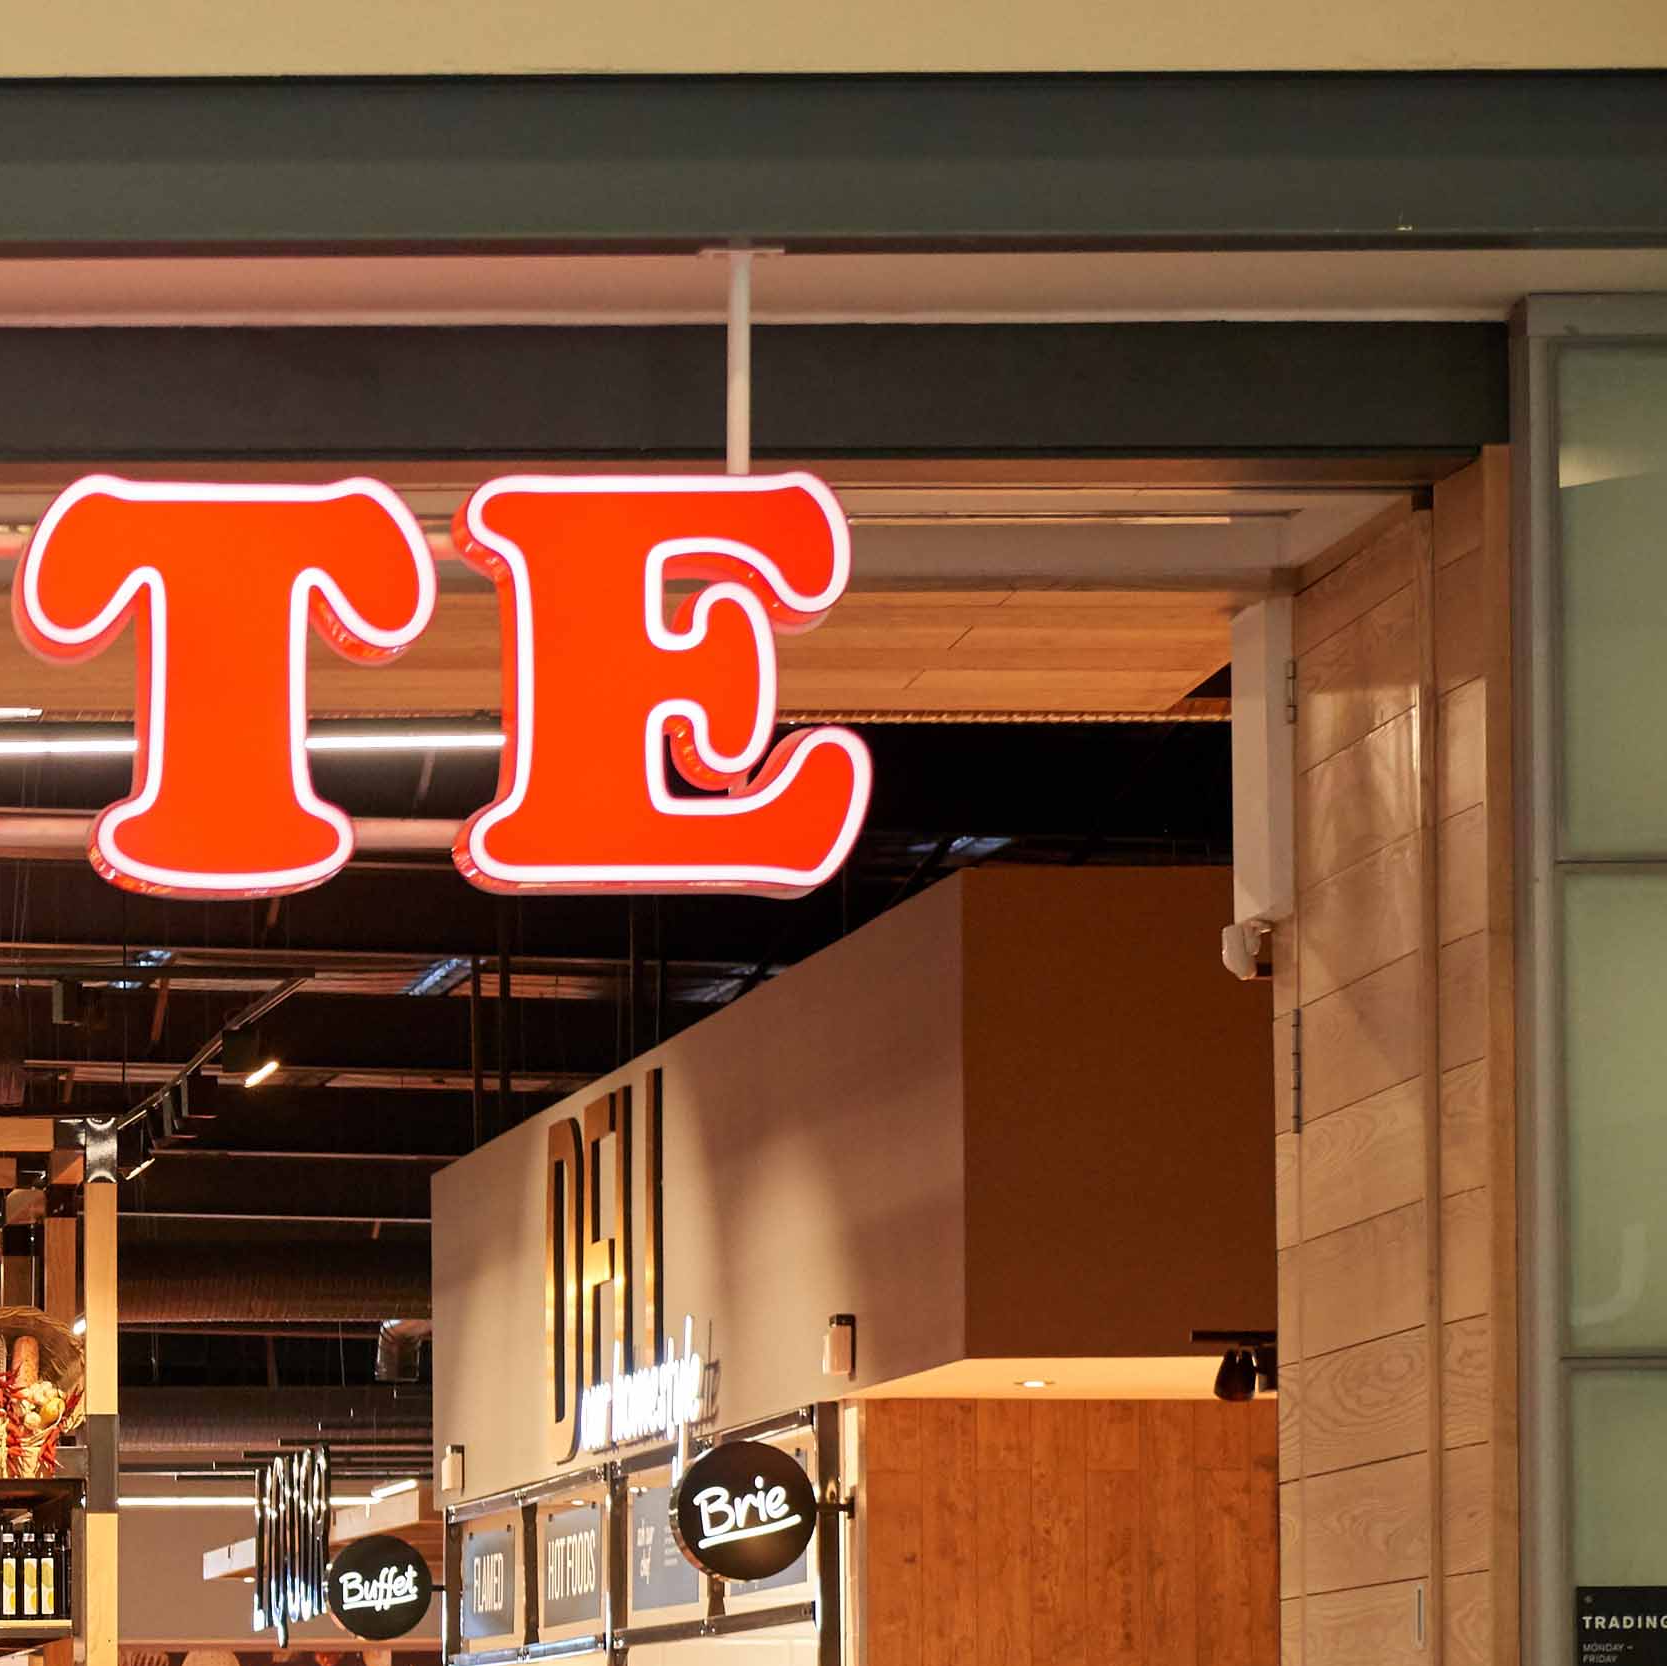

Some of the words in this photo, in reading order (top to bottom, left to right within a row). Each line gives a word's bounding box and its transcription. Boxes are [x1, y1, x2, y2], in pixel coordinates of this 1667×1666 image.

[692, 1475, 790, 1537] Brie
[547, 1538, 566, 1601] HOT
[567, 1529, 597, 1597] FOODS
[338, 1563, 418, 1612] Buffet
[1582, 1615, 1667, 1629] TRADING
[1582, 1643, 1625, 1652] MONDAY
[1582, 1654, 1618, 1663] FRIDAY
